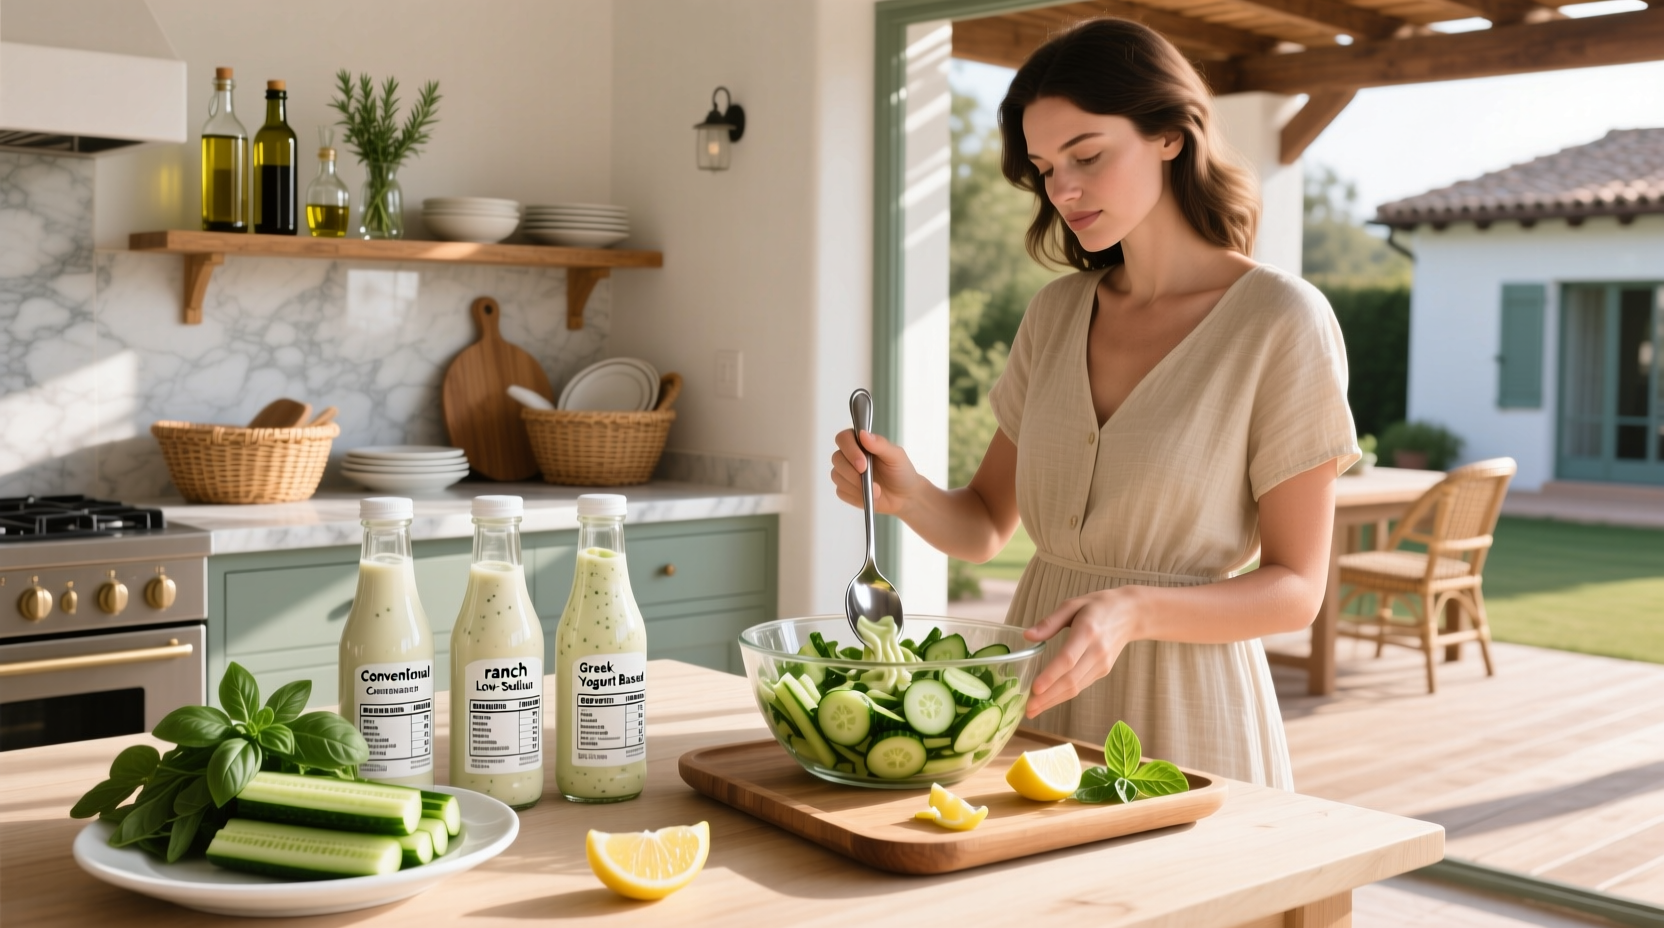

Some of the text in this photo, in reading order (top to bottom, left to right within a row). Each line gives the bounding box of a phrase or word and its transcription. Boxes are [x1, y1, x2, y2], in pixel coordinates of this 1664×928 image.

[485, 662, 527, 679] ranch
[580, 661, 615, 673] Greek
[578, 675, 616, 690] Yogurt
